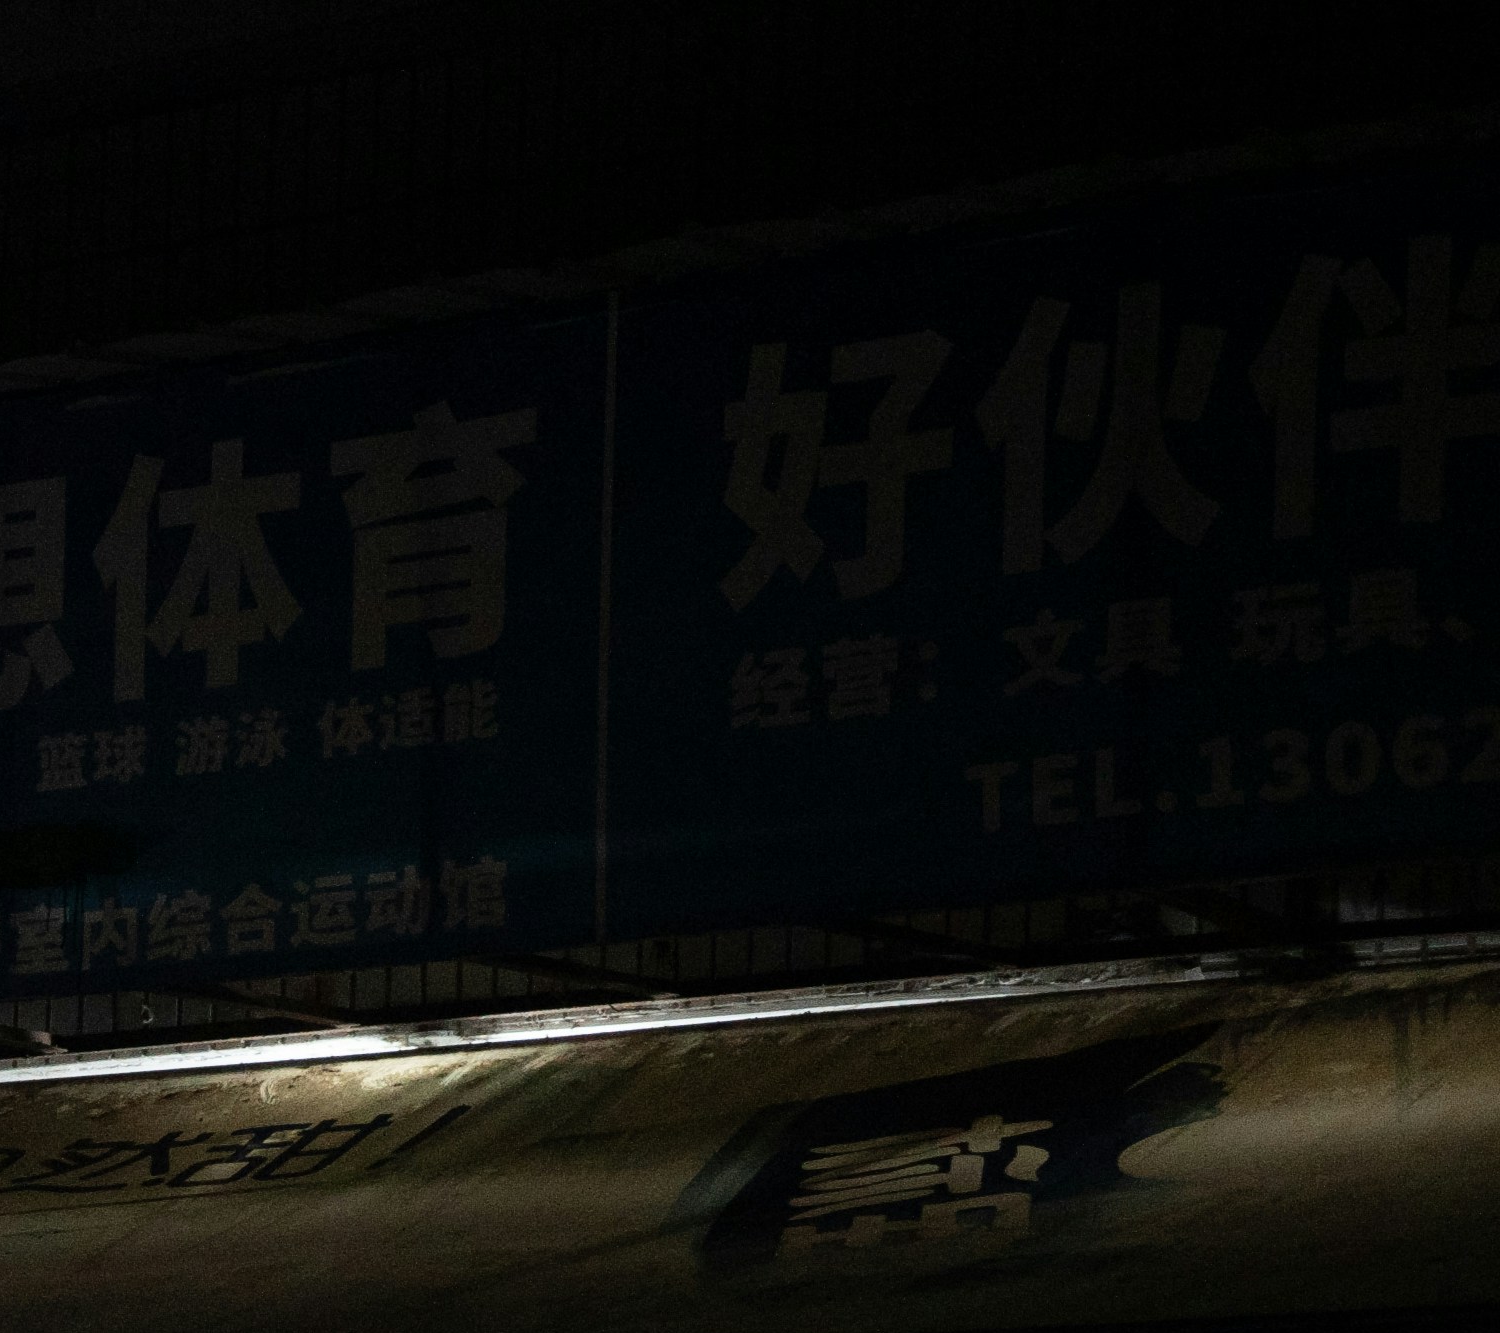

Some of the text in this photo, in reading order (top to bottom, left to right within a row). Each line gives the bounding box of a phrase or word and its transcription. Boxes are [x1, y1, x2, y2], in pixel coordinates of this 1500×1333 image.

[1002, 610, 1182, 701] 文具
[35, 724, 149, 796] 篮球
[175, 708, 289, 778] 游泳
[318, 677, 501, 761] 体适能
